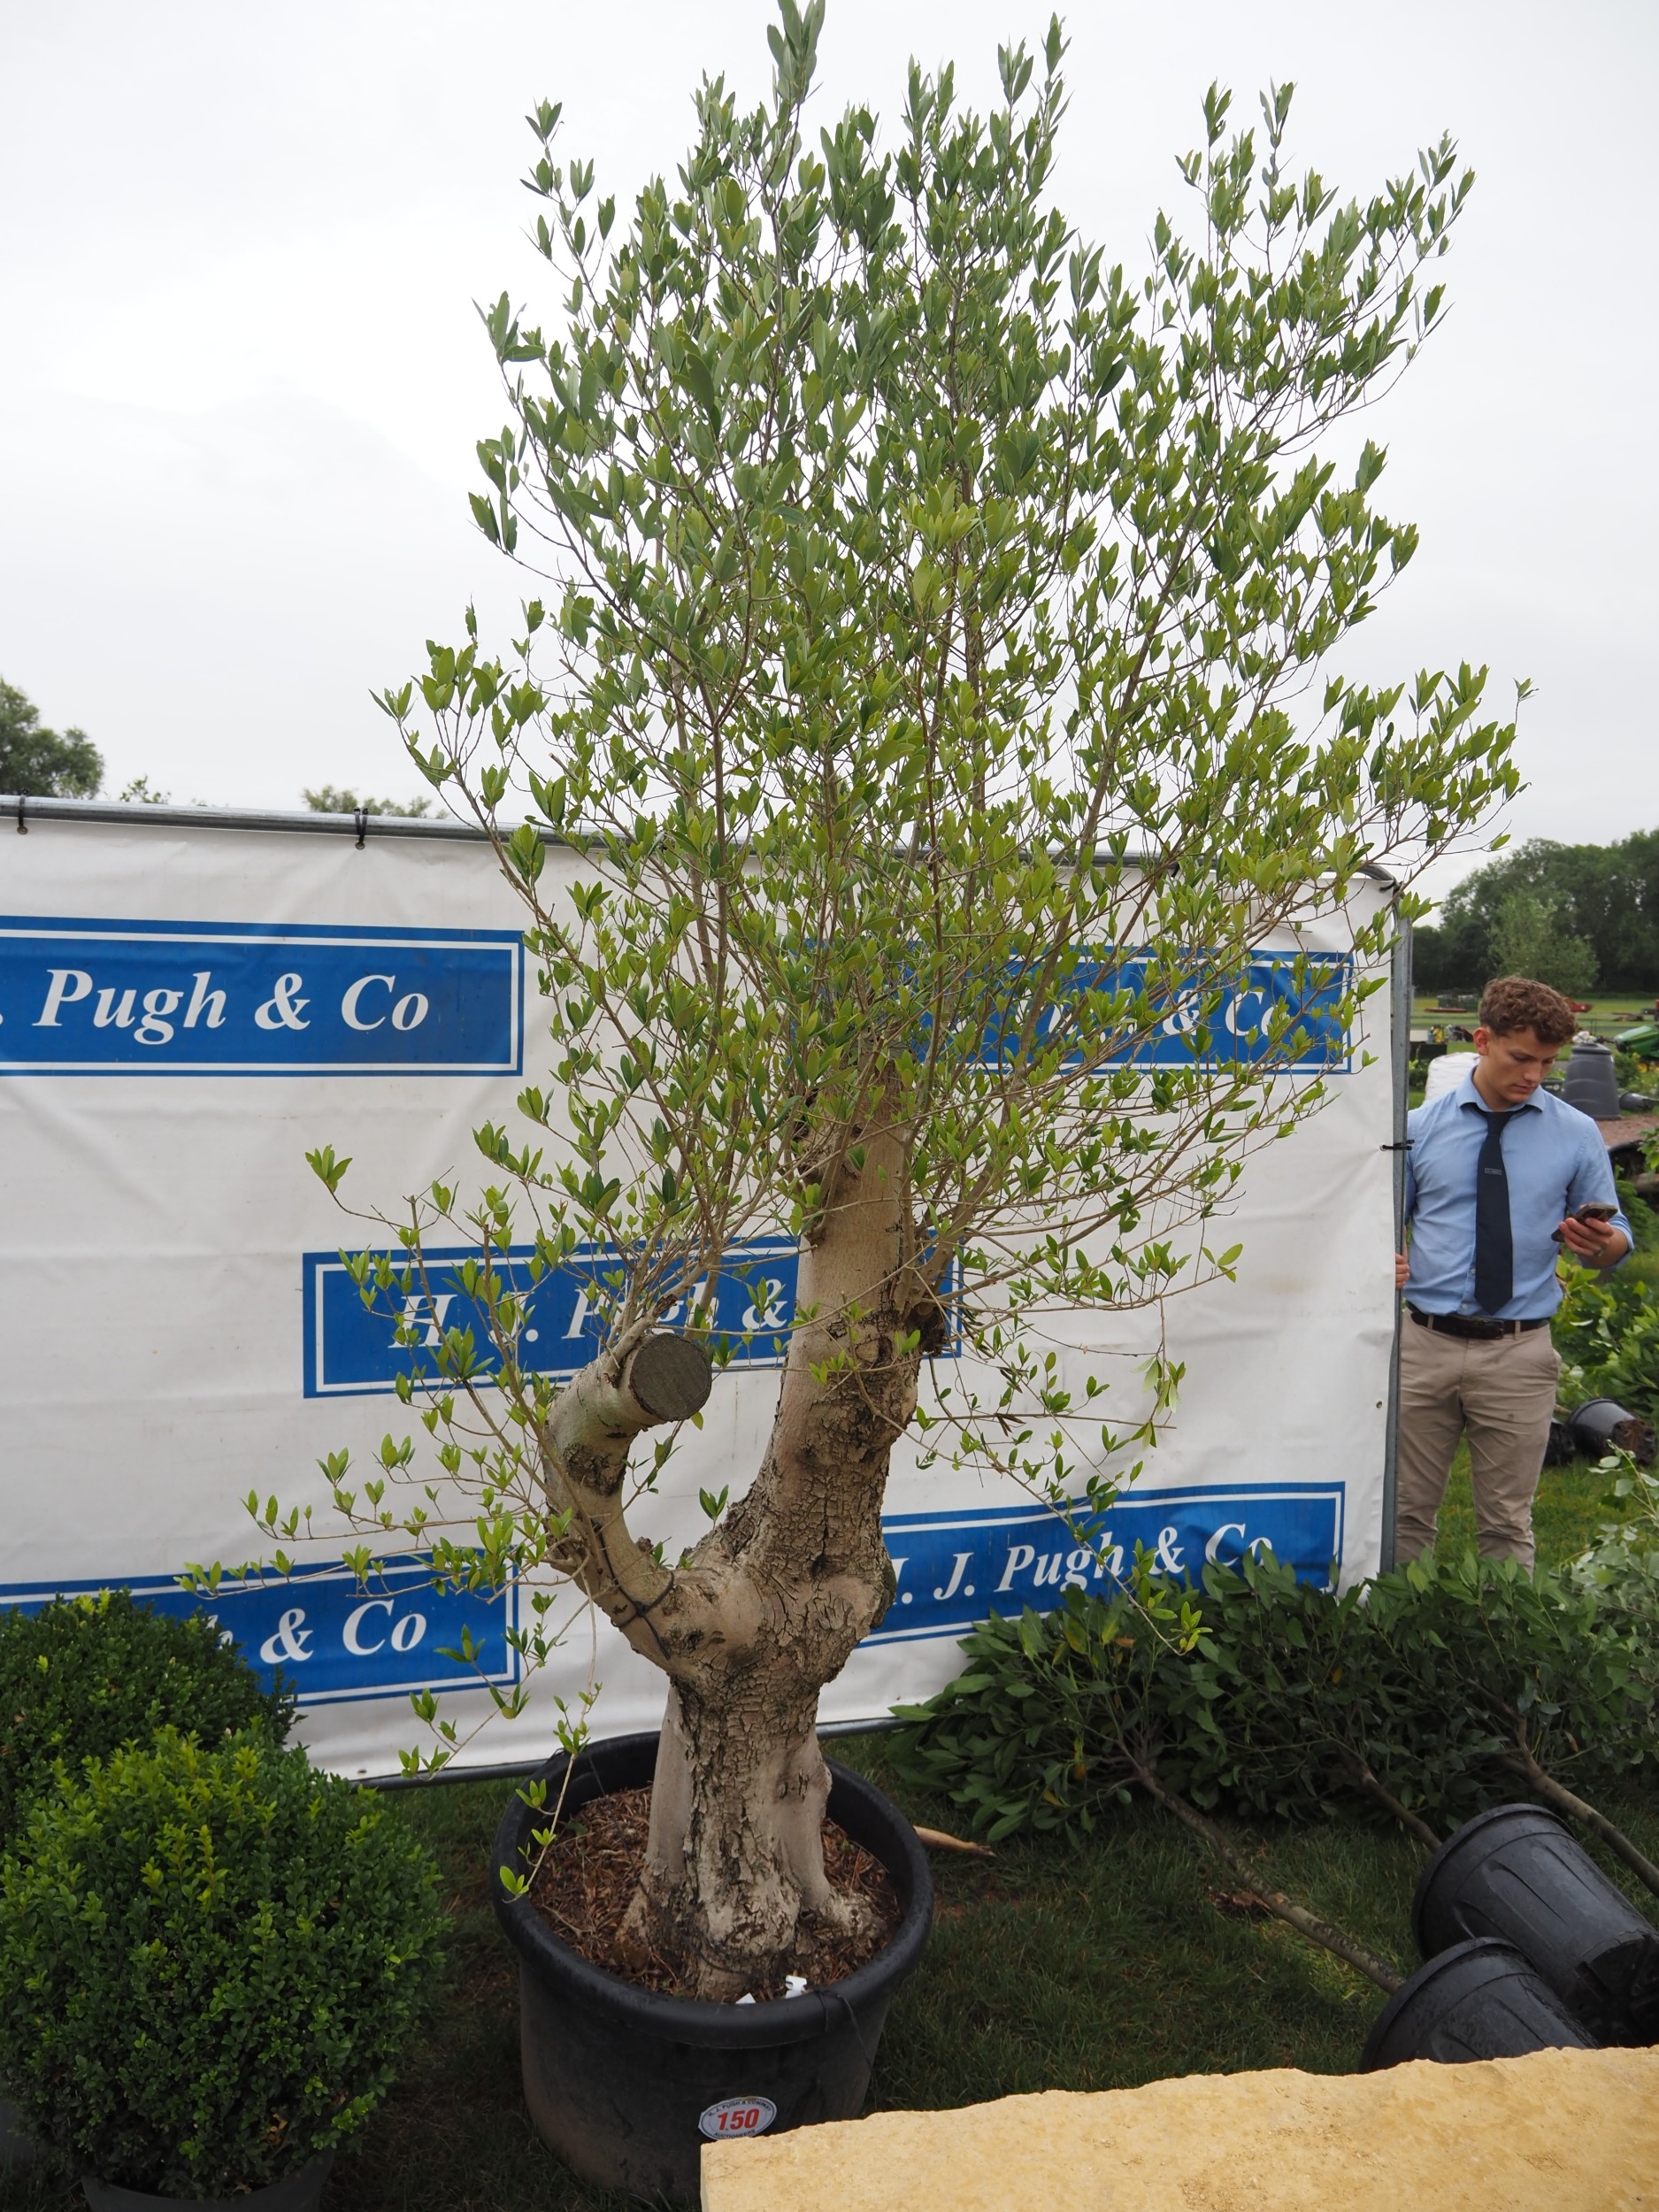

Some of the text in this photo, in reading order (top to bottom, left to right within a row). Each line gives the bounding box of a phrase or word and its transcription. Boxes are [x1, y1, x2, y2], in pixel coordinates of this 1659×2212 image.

[32, 969, 430, 1046] Pugh & Co
[741, 1279, 789, 1330] &
[933, 1552, 975, 1601] J.
[993, 1531, 1125, 1594] Pugh
[1148, 1526, 1186, 1576] &
[259, 1607, 314, 1664] &
[342, 1599, 427, 1656] Co
[718, 2108, 760, 2131] 150
